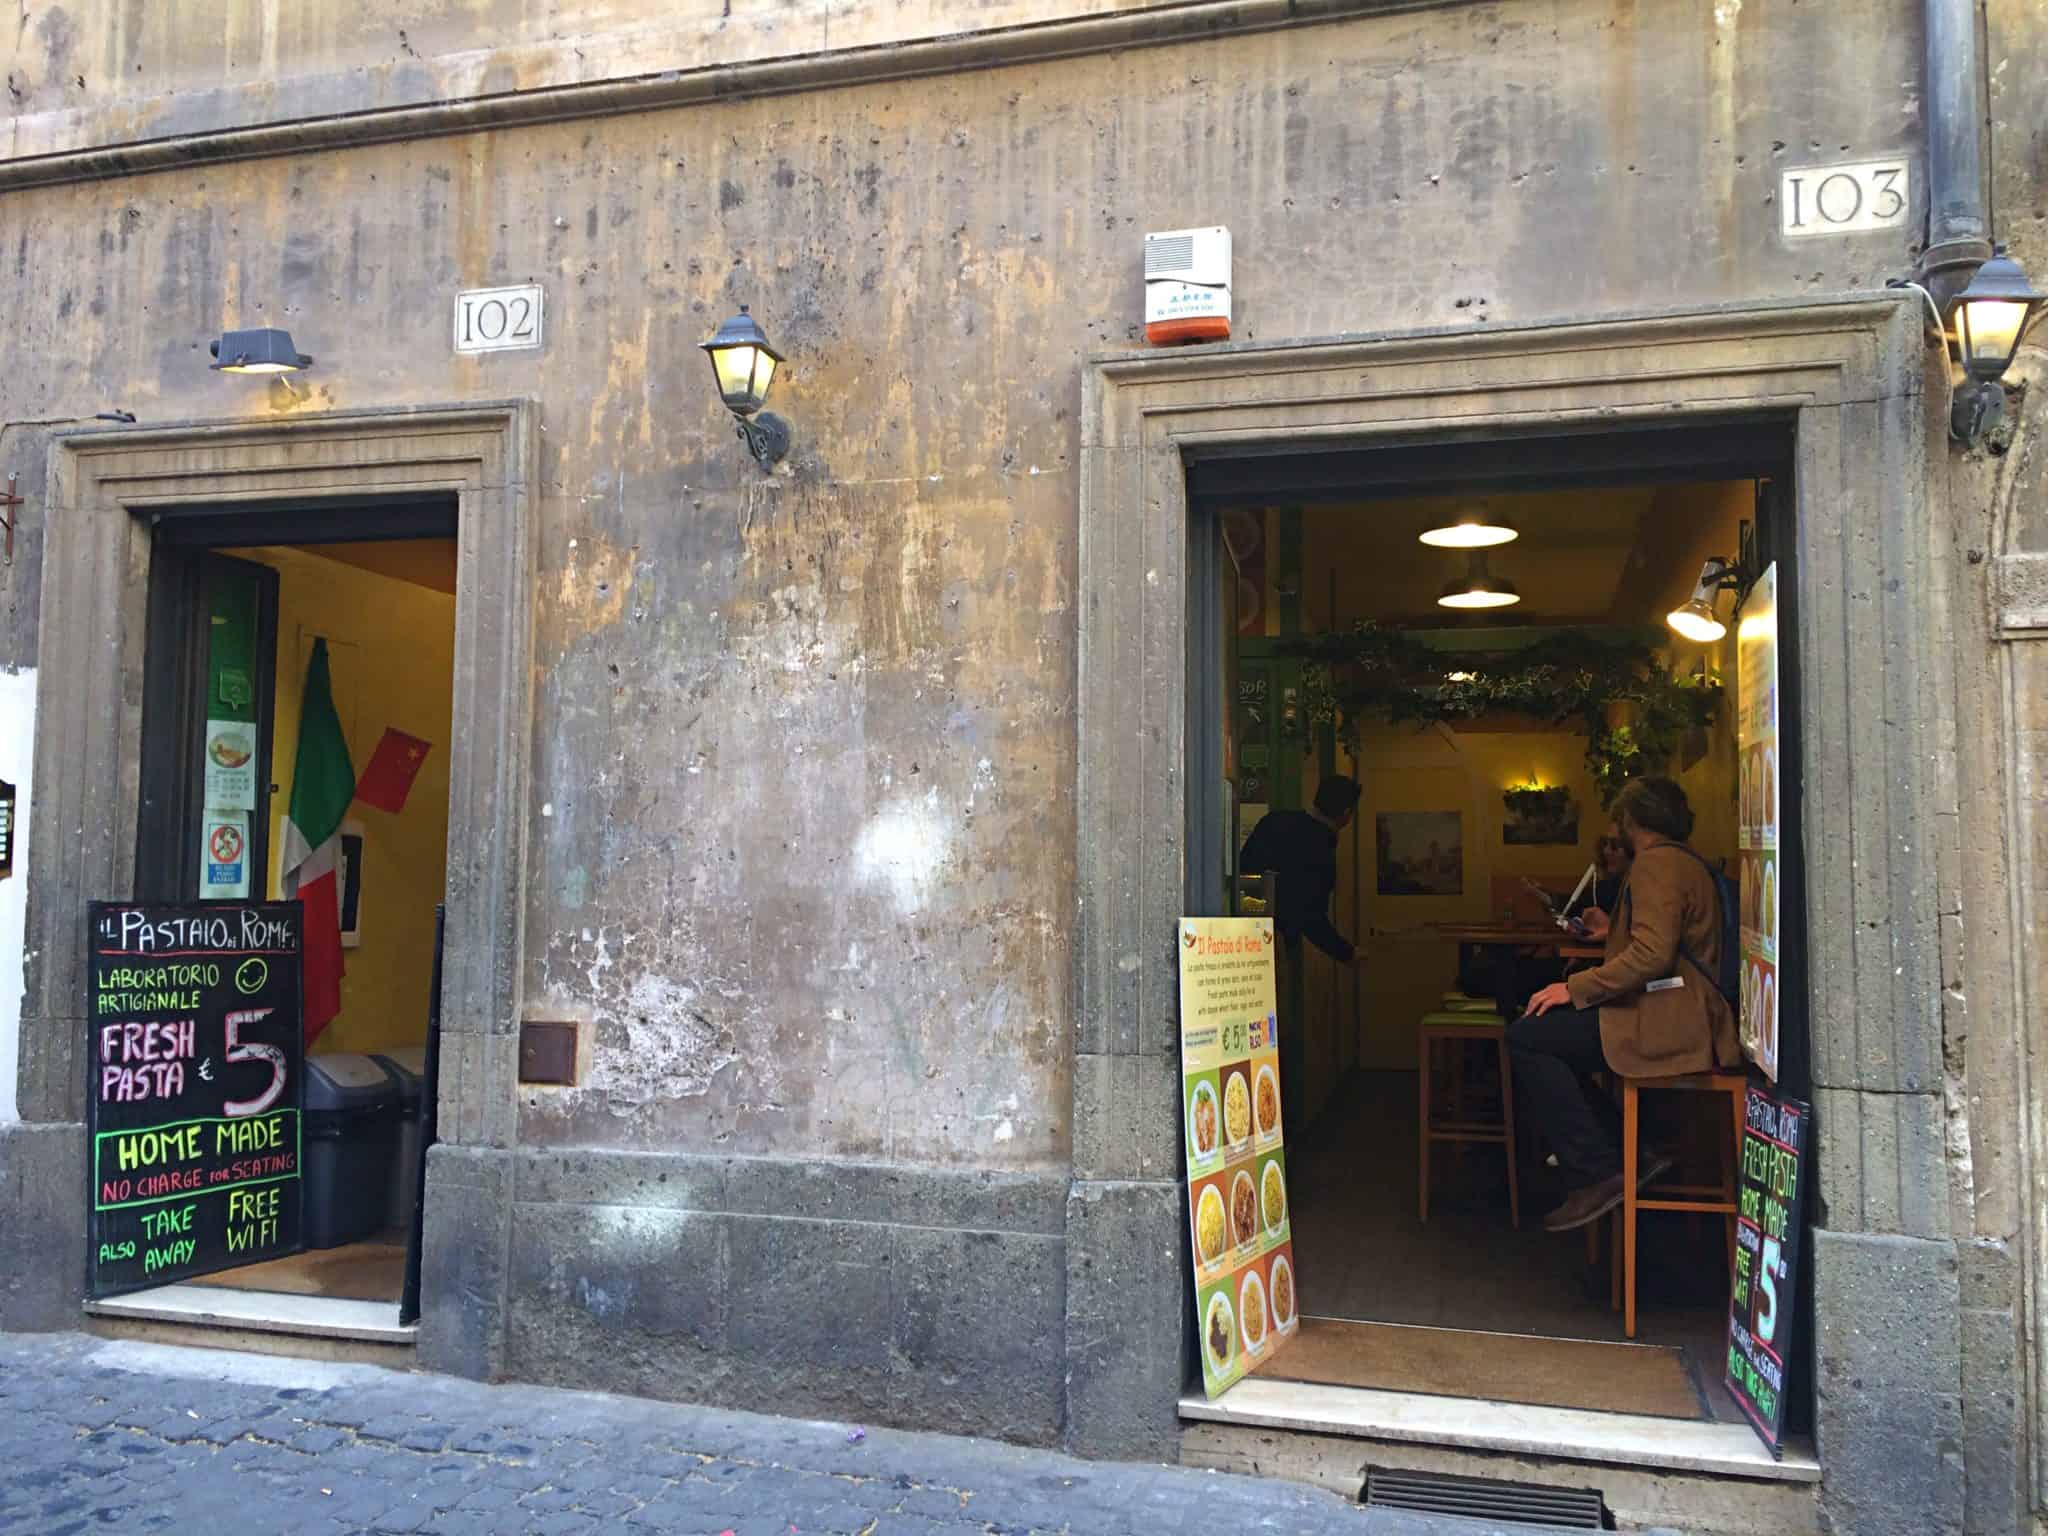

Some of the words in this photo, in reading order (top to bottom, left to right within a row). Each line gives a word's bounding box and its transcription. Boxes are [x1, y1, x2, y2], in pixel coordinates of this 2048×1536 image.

[1788, 168, 1903, 228] 103
[463, 296, 535, 342] 102
[120, 911, 228, 952] PASTAIO
[240, 909, 297, 949] ROMA
[1207, 935, 1233, 956] Pastaio
[98, 963, 220, 990] LABORATORIO
[98, 990, 201, 1015] ARTIGIANALE
[100, 1019, 196, 1063] FRESH
[223, 1007, 287, 1117] 5
[102, 1061, 185, 1102] PASTA
[118, 1125, 203, 1171] HOME
[216, 1117, 284, 1155] MADE
[102, 1180, 131, 1204] NO
[136, 1167, 204, 1197] CHARGE
[231, 1152, 296, 1179] SEATING
[1768, 1142, 1799, 1201] PASTA
[140, 1203, 198, 1241] TAKE
[228, 1187, 282, 1224] FREE
[1764, 1196, 1789, 1242] MADE
[99, 1240, 136, 1265] ALSO
[144, 1239, 197, 1273] AWAY
